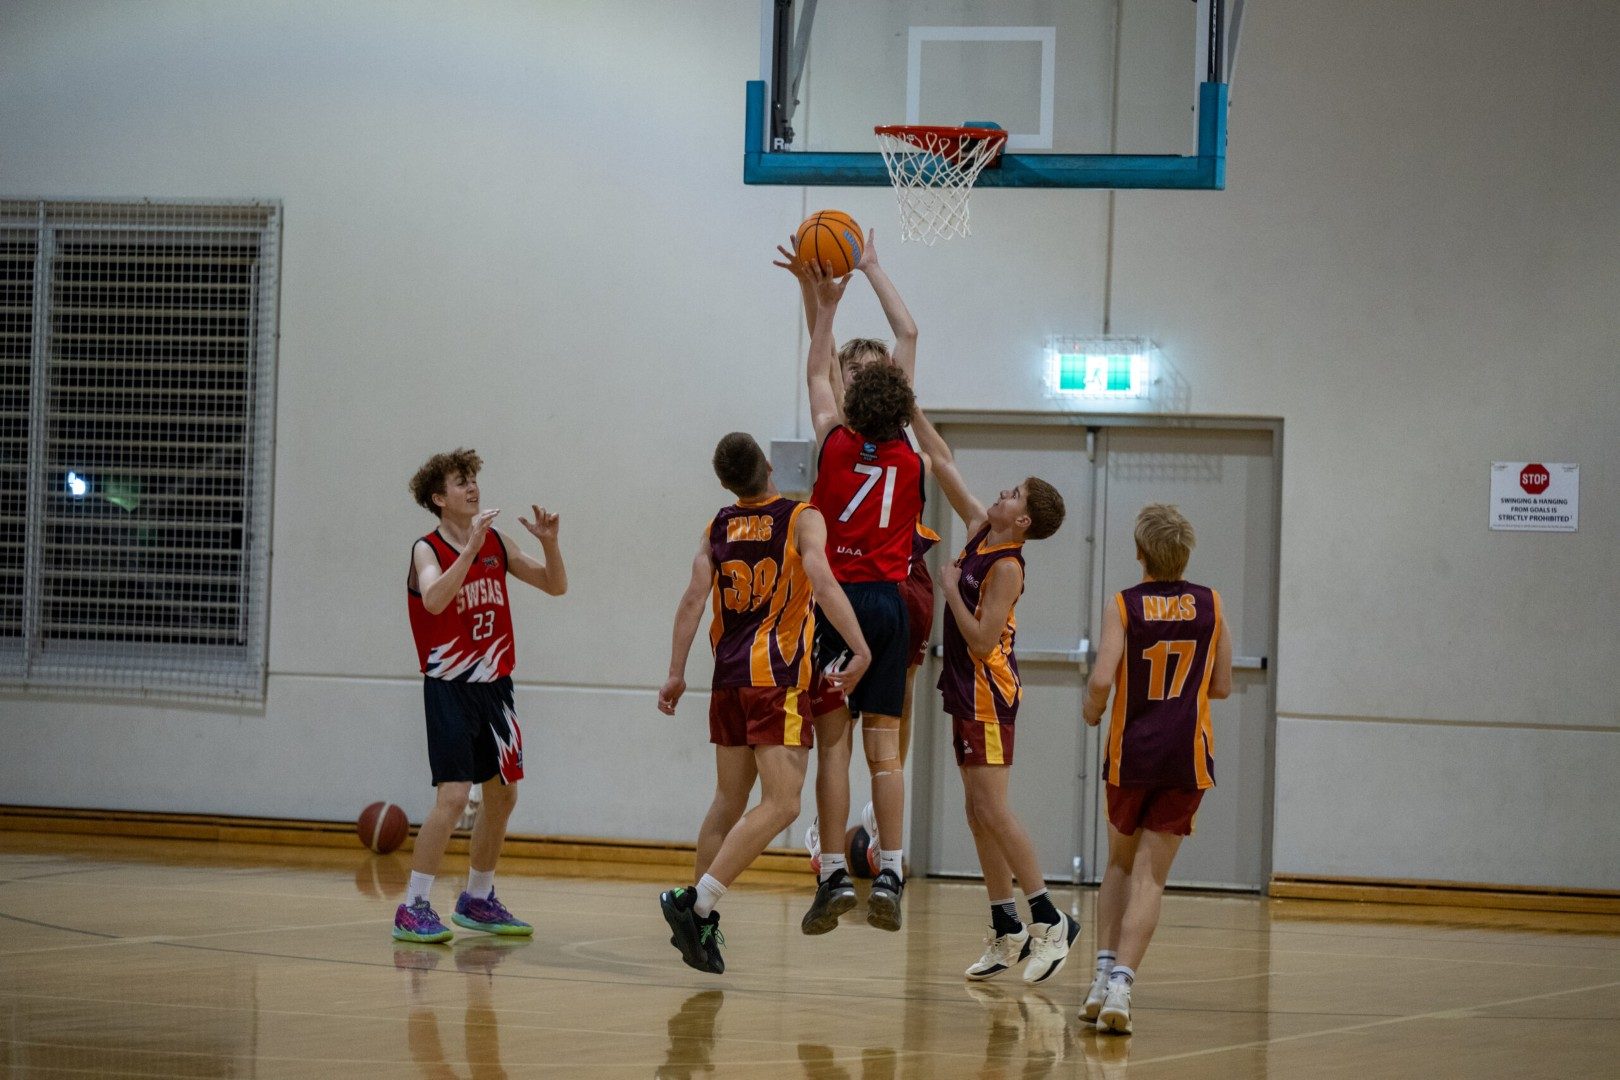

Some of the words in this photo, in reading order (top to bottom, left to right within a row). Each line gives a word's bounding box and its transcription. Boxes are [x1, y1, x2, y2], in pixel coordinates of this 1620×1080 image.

[1521, 473, 1548, 485] STOP
[838, 463, 897, 528] 71
[1142, 593, 1197, 621] NIAS
[472, 610, 495, 640] 23
[1142, 640, 1197, 700] 17
